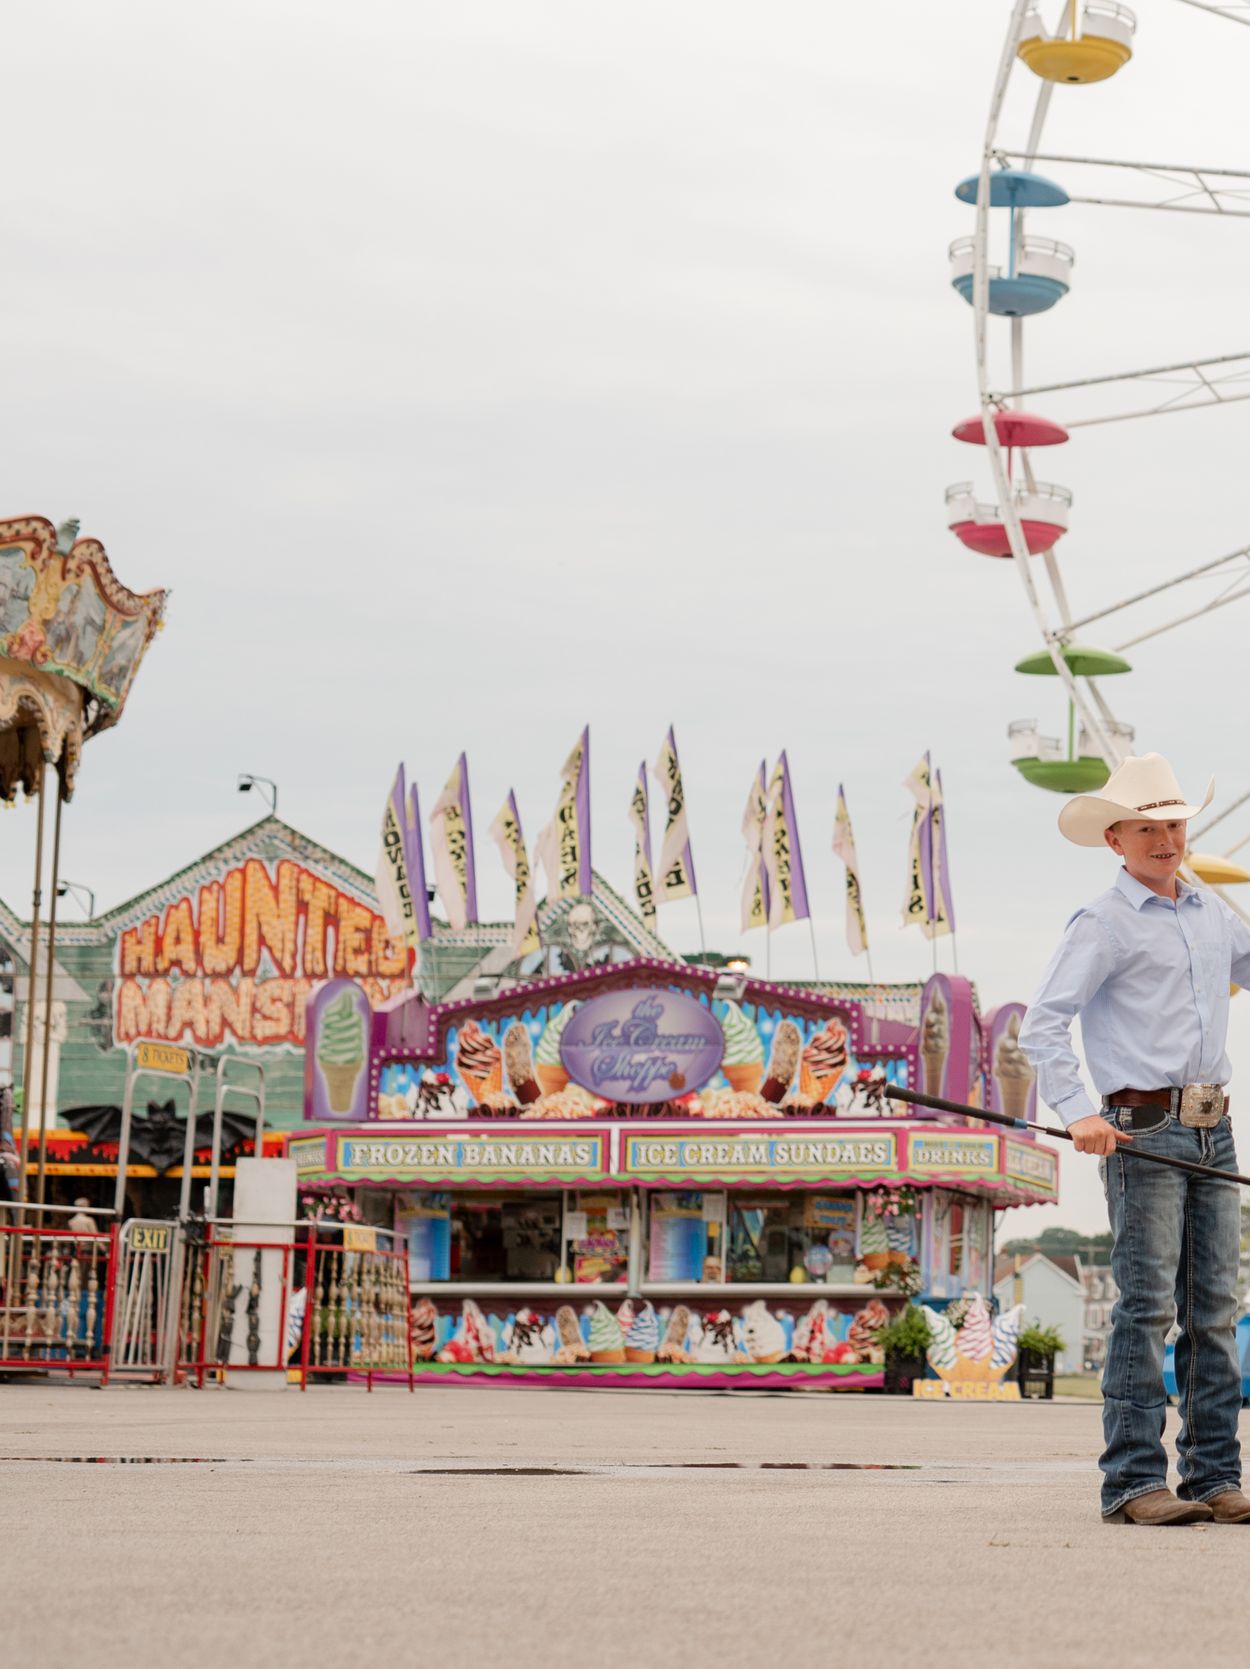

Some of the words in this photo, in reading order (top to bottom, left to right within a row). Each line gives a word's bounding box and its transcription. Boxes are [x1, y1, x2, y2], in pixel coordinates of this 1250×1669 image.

[120, 857, 416, 978] HAUNTED
[115, 977, 414, 1046] MANSI
[621, 1018, 706, 1053] Cream
[592, 1051, 677, 1092] Shoppe
[351, 1143, 454, 1167] FROZEN
[463, 1142, 592, 1167] BANANAS
[637, 1143, 677, 1166] ICE
[683, 1143, 769, 1166] CREAM
[774, 1142, 888, 1166] SUNDAES
[917, 1150, 990, 1165] DRINKS
[133, 1228, 166, 1248] EXIT
[913, 1379, 944, 1399] ICE
[951, 1381, 1021, 1400] CREAM
